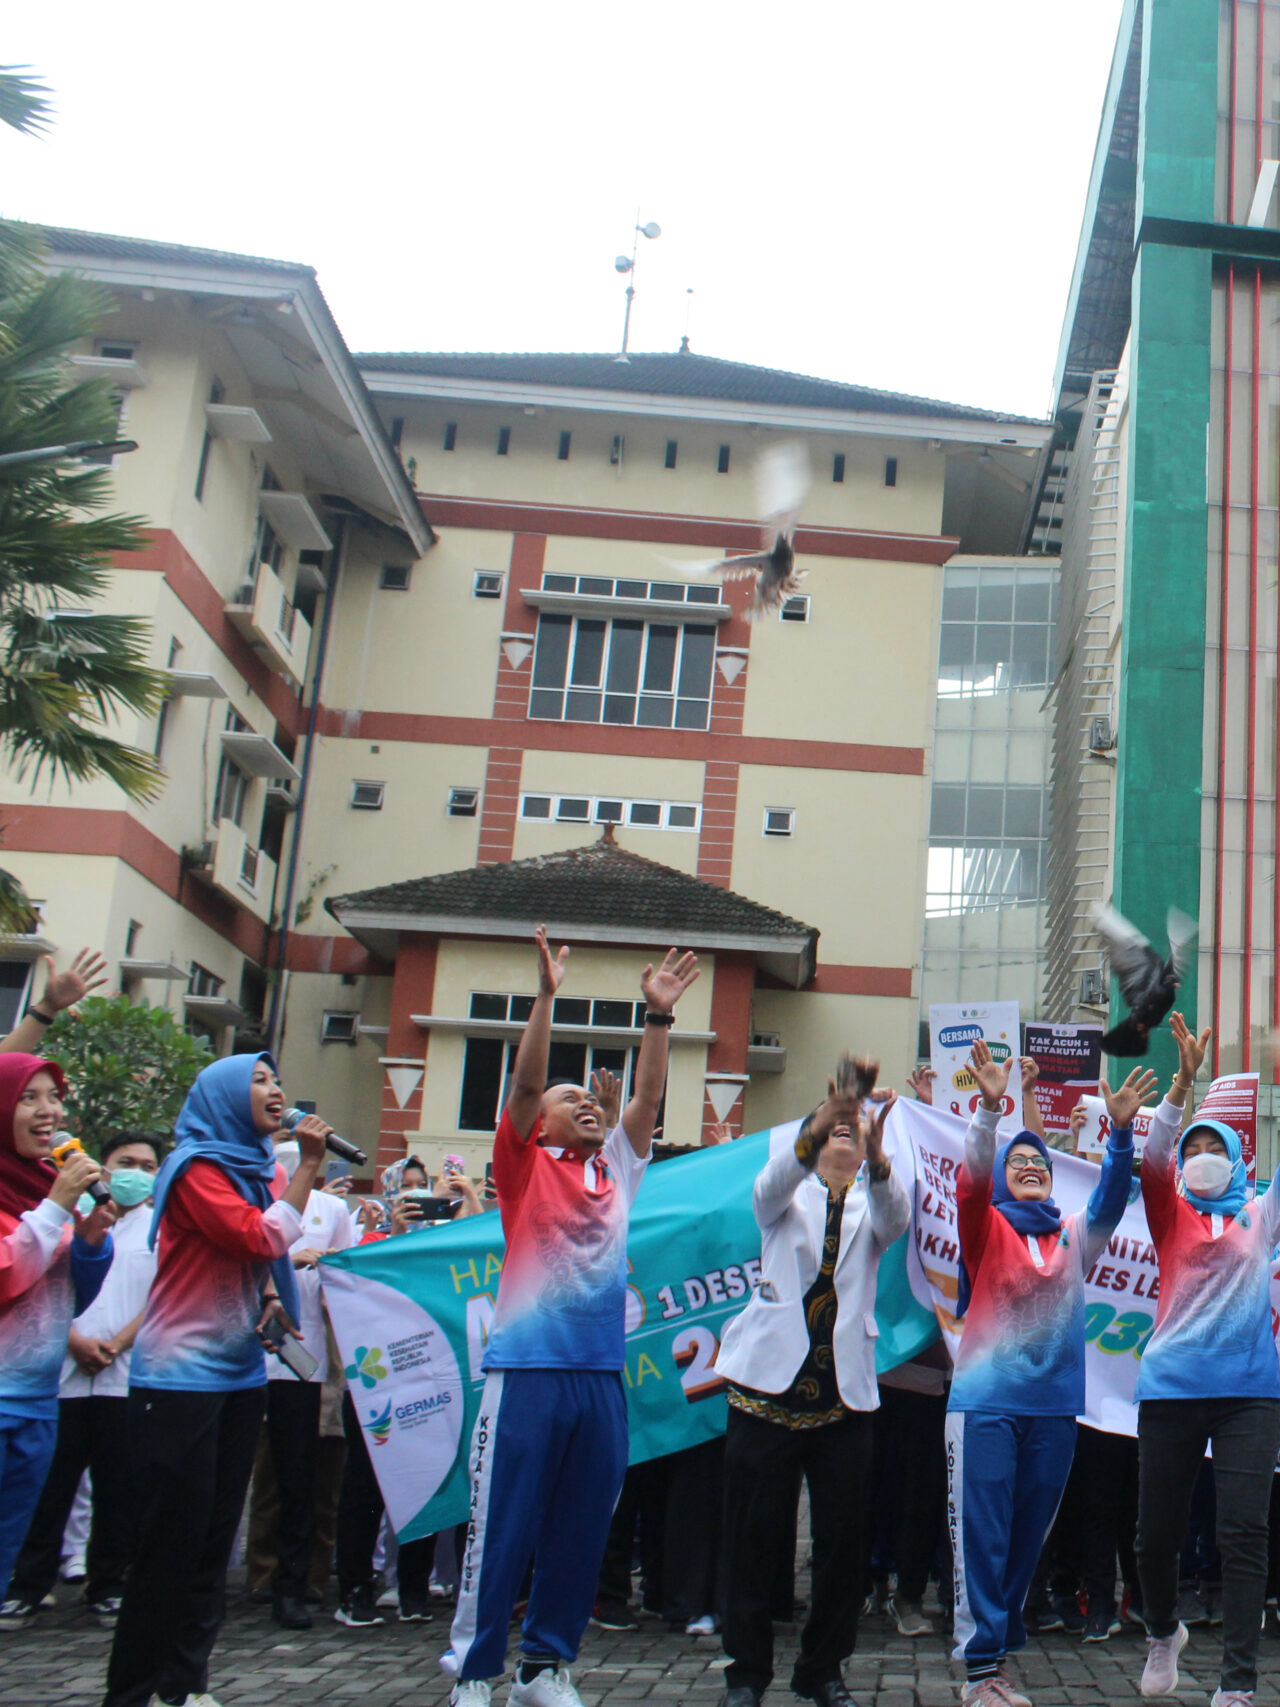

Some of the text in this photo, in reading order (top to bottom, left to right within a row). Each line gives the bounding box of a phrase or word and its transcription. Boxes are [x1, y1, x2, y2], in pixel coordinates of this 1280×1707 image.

[940, 1029, 982, 1044] BERSAMA
[1029, 1045, 1090, 1057] KETAKUTAN
[1030, 1036, 1051, 1046] TAK
[1052, 1037, 1082, 1047] ACUH
[921, 1191, 956, 1226] LET
[658, 1286, 685, 1319] 1
[394, 1391, 452, 1420] GERMAS
[474, 1416, 490, 1474] KOTA
